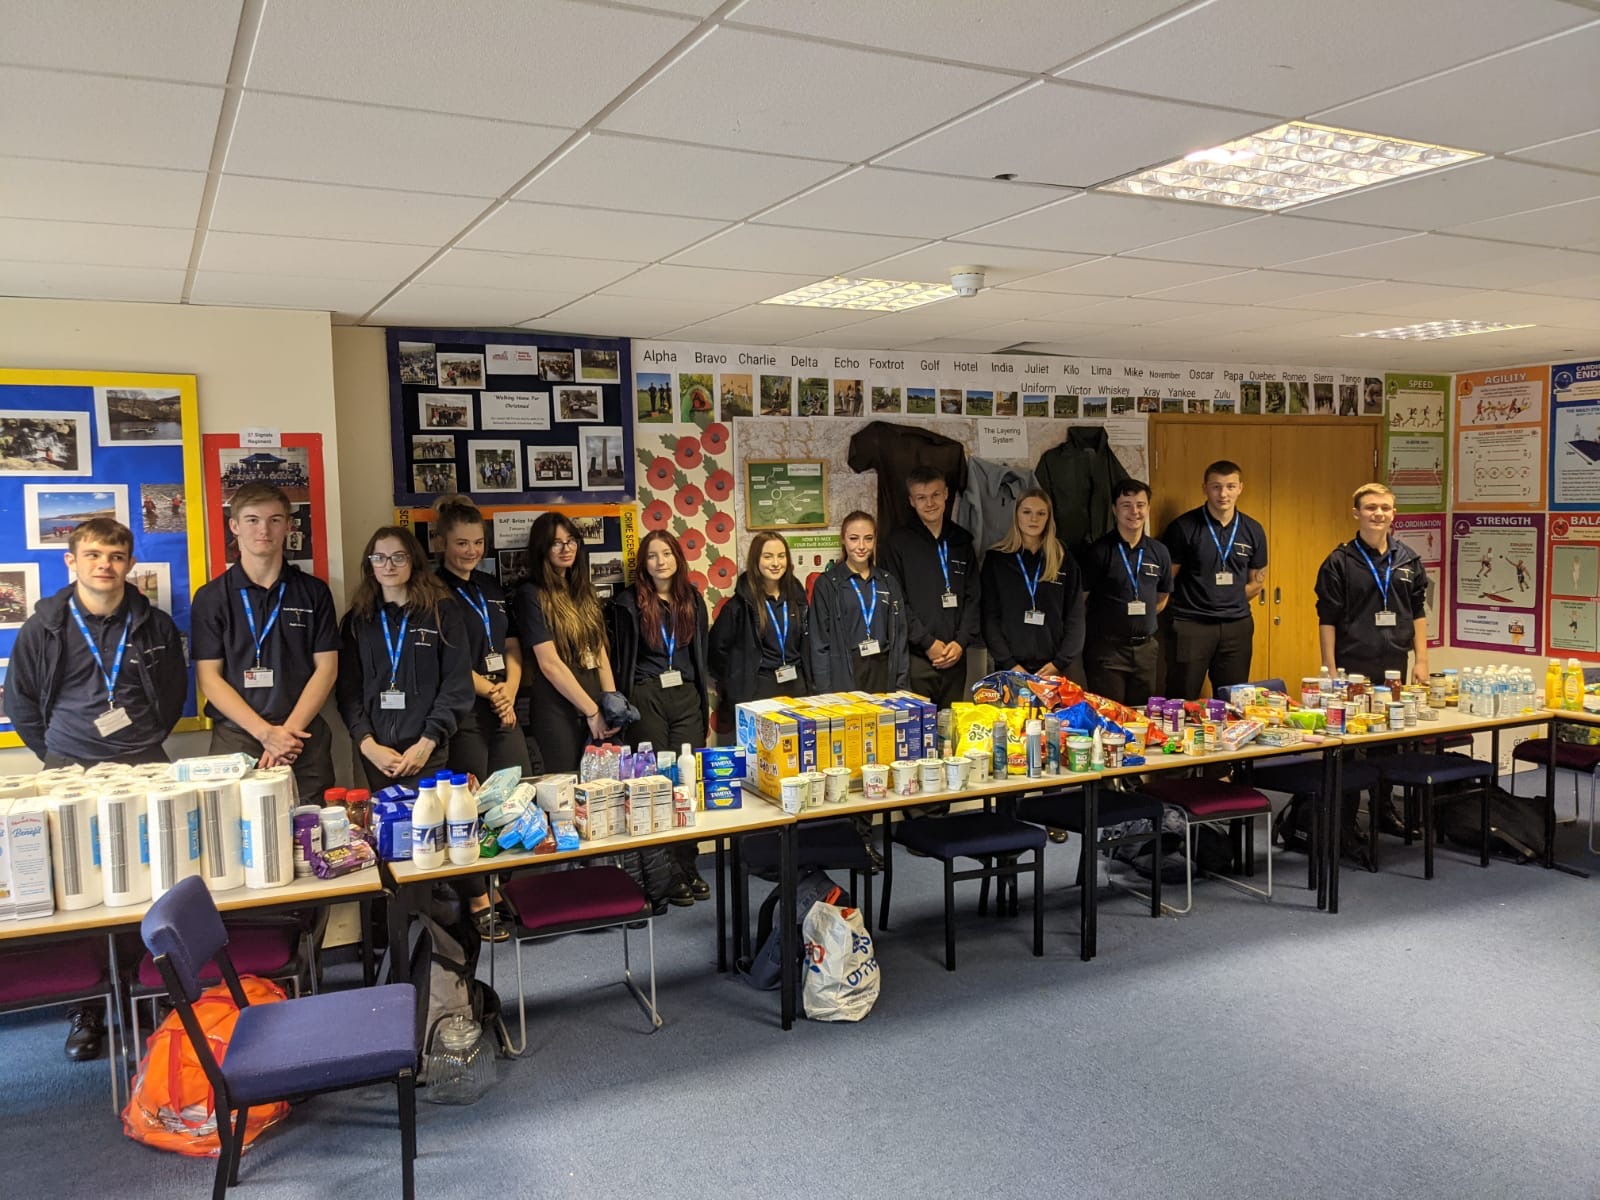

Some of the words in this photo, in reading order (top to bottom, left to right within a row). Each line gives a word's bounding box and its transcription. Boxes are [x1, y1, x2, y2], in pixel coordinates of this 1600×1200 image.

[643, 350, 677, 364] Alpha
[695, 352, 727, 364] Bravo
[738, 353, 777, 366] Charlie
[791, 355, 818, 368] Delta
[834, 357, 860, 369] Echo
[869, 358, 904, 371] Foxtrot
[920, 359, 940, 371] Golf
[954, 361, 978, 372] Hotel
[991, 362, 1014, 373] India
[1024, 363, 1049, 374] Juliet
[1063, 364, 1080, 375] Kilo
[1091, 365, 1112, 376] Lima
[1124, 366, 1144, 378] Mike
[1149, 370, 1181, 379] November
[1189, 368, 1214, 380] Oscar
[1223, 370, 1244, 383] Papa
[1249, 370, 1276, 382] Quebec
[1282, 371, 1307, 382] Romeo
[1313, 372, 1334, 383] Sierra
[1341, 374, 1362, 384] Tango
[1485, 373, 1527, 385] AGILITY
[1021, 382, 1057, 394] Uniform
[1066, 384, 1091, 395] Victor
[1408, 380, 1433, 389] SPEED
[1098, 385, 1130, 397] Whiskey
[1143, 387, 1160, 398] Xray
[1168, 387, 1196, 398] Yankee
[1214, 389, 1231, 399] Zulu
[984, 427, 995, 435] The
[996, 427, 1021, 436] Layering
[992, 437, 1014, 445] System
[624, 511, 634, 533] CRIME
[1395, 519, 1441, 529] CO-ORDINATION
[1476, 516, 1531, 525] STRENGTH
[626, 534, 635, 556] SCENE
